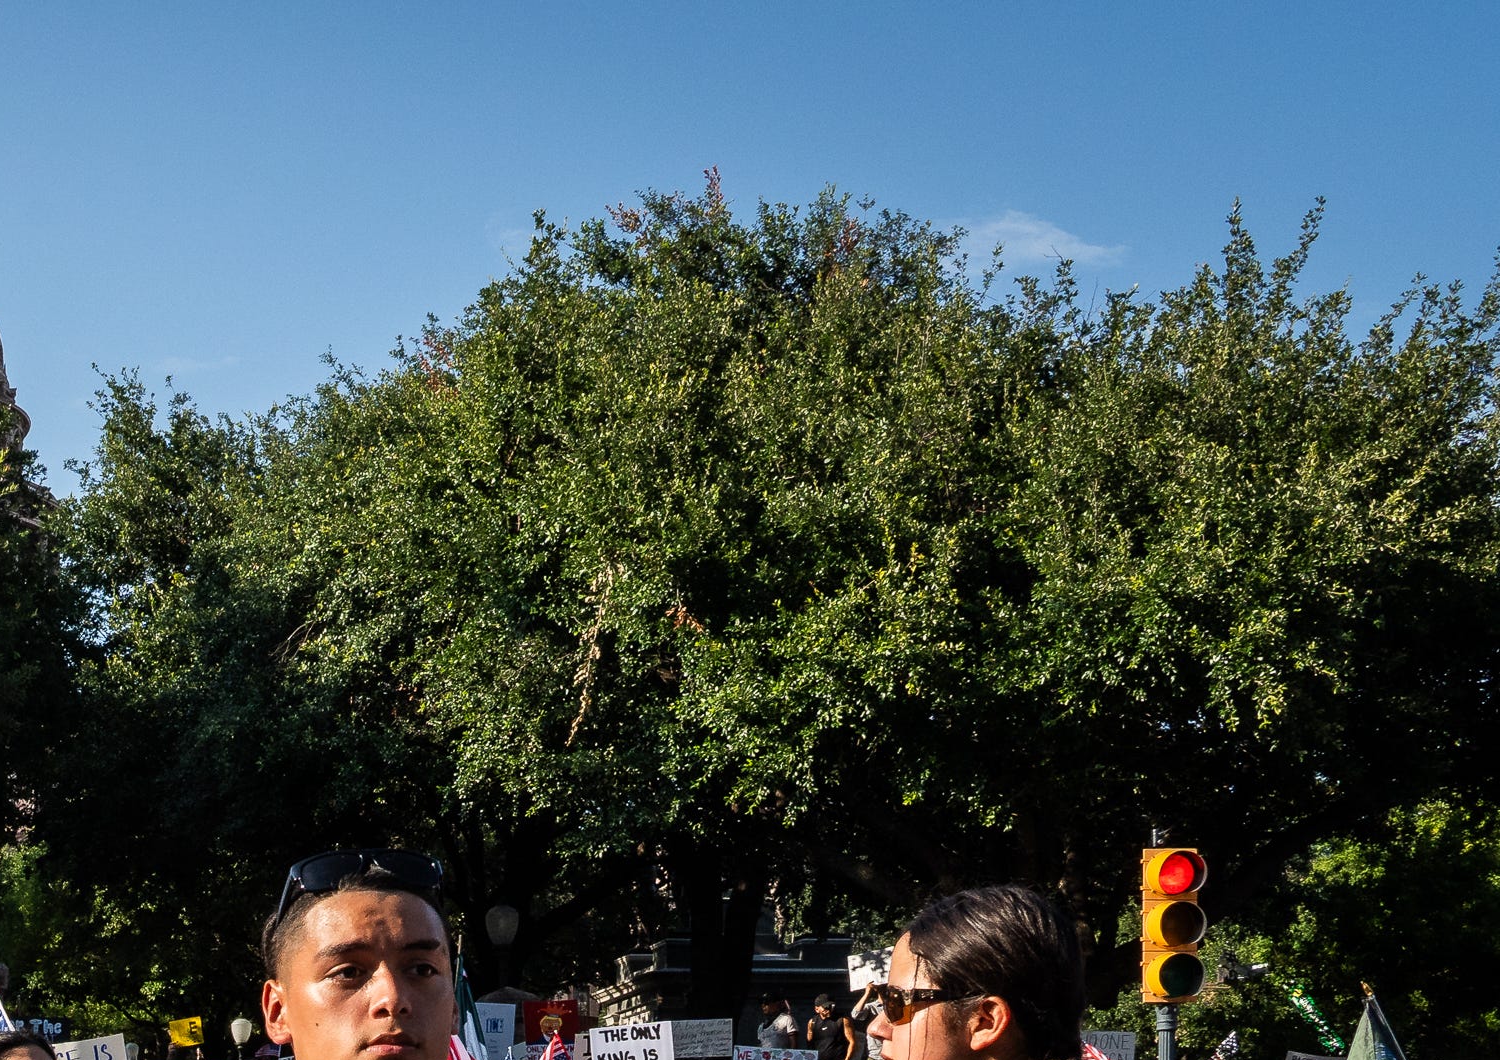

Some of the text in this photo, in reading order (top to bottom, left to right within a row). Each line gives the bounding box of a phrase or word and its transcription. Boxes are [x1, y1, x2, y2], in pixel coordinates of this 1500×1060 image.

[599, 1024, 661, 1043] THE ONLY
[1101, 1033, 1131, 1050] ONE
[737, 1050, 752, 1060] WE
